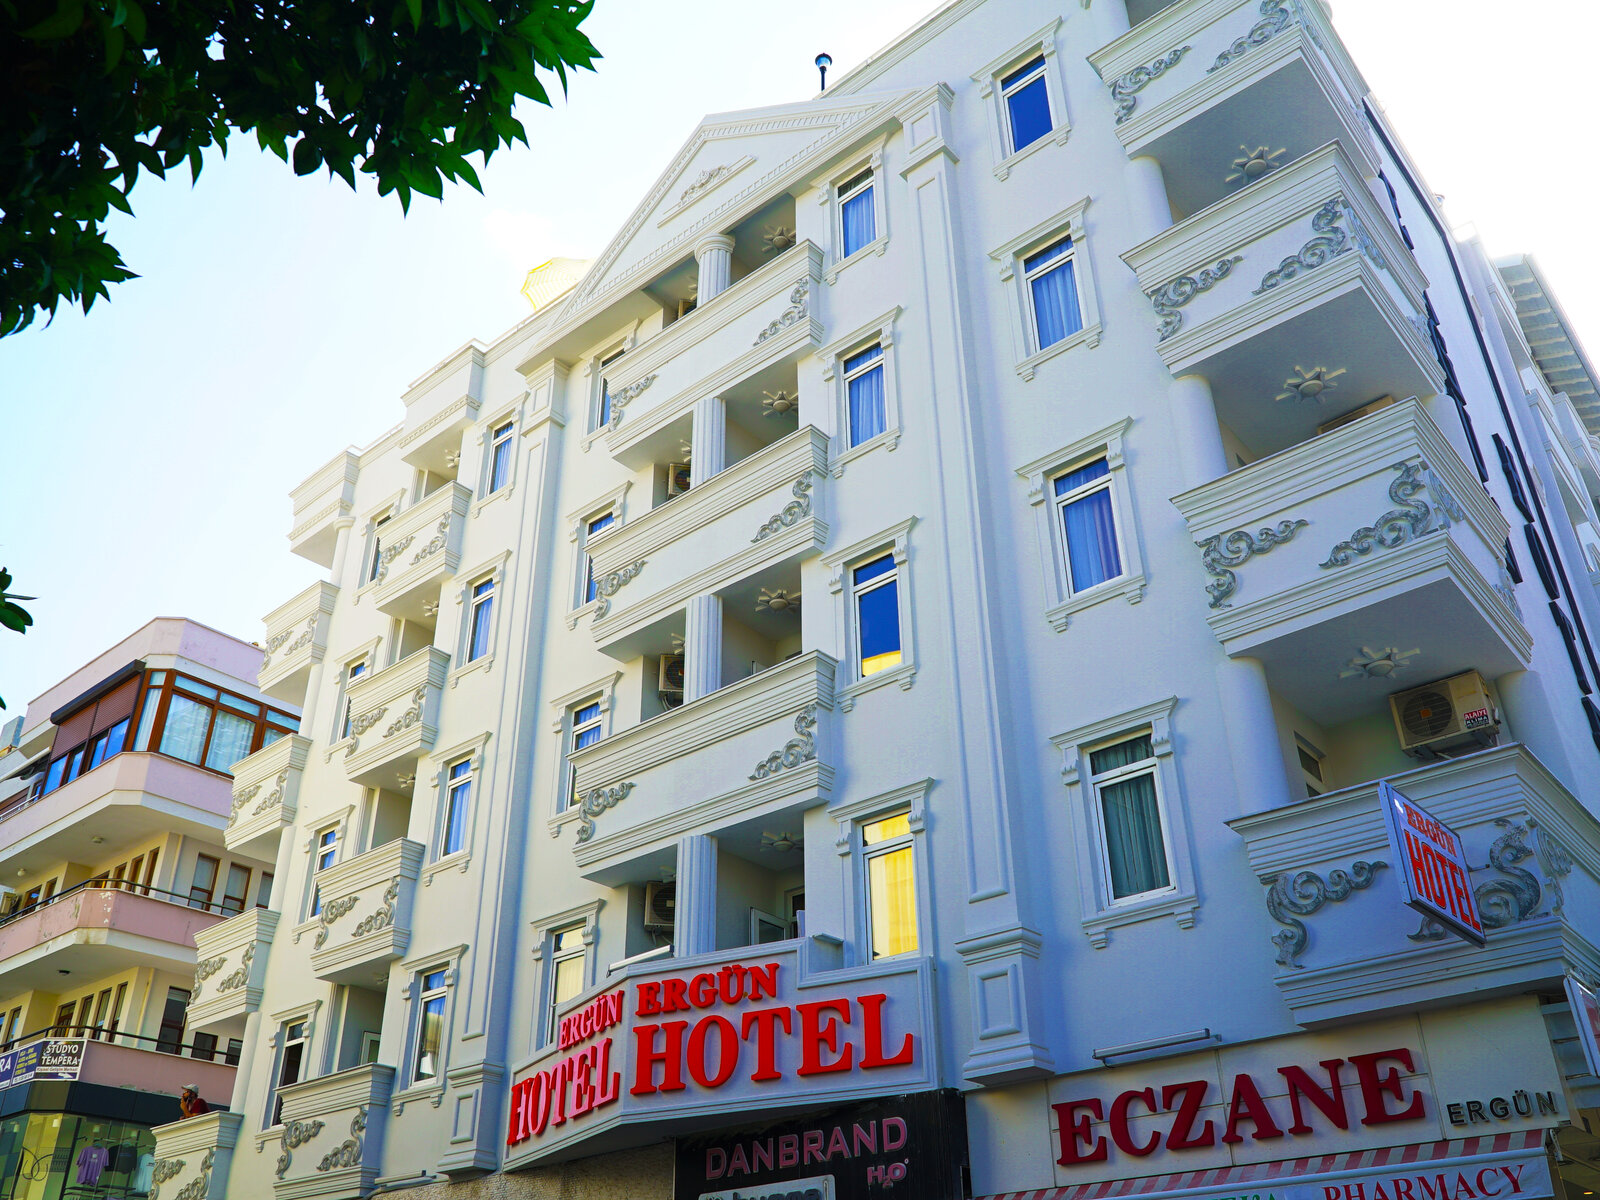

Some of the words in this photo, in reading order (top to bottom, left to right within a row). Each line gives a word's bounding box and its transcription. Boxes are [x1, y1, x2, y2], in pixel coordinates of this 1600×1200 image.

[1403, 802, 1457, 858] ERGÜN
[1404, 829, 1482, 933] HOTEL
[558, 990, 625, 1051] ERGÜN
[636, 963, 780, 1016] ERGÜN
[41, 1056, 78, 1065] TEMPERA
[630, 993, 914, 1095] HOTEL
[506, 1037, 621, 1147] HOTEL
[1051, 1048, 1425, 1165] ECZANE
[1447, 1089, 1559, 1125] ERGÜN
[706, 1117, 908, 1180] DANBRAND
